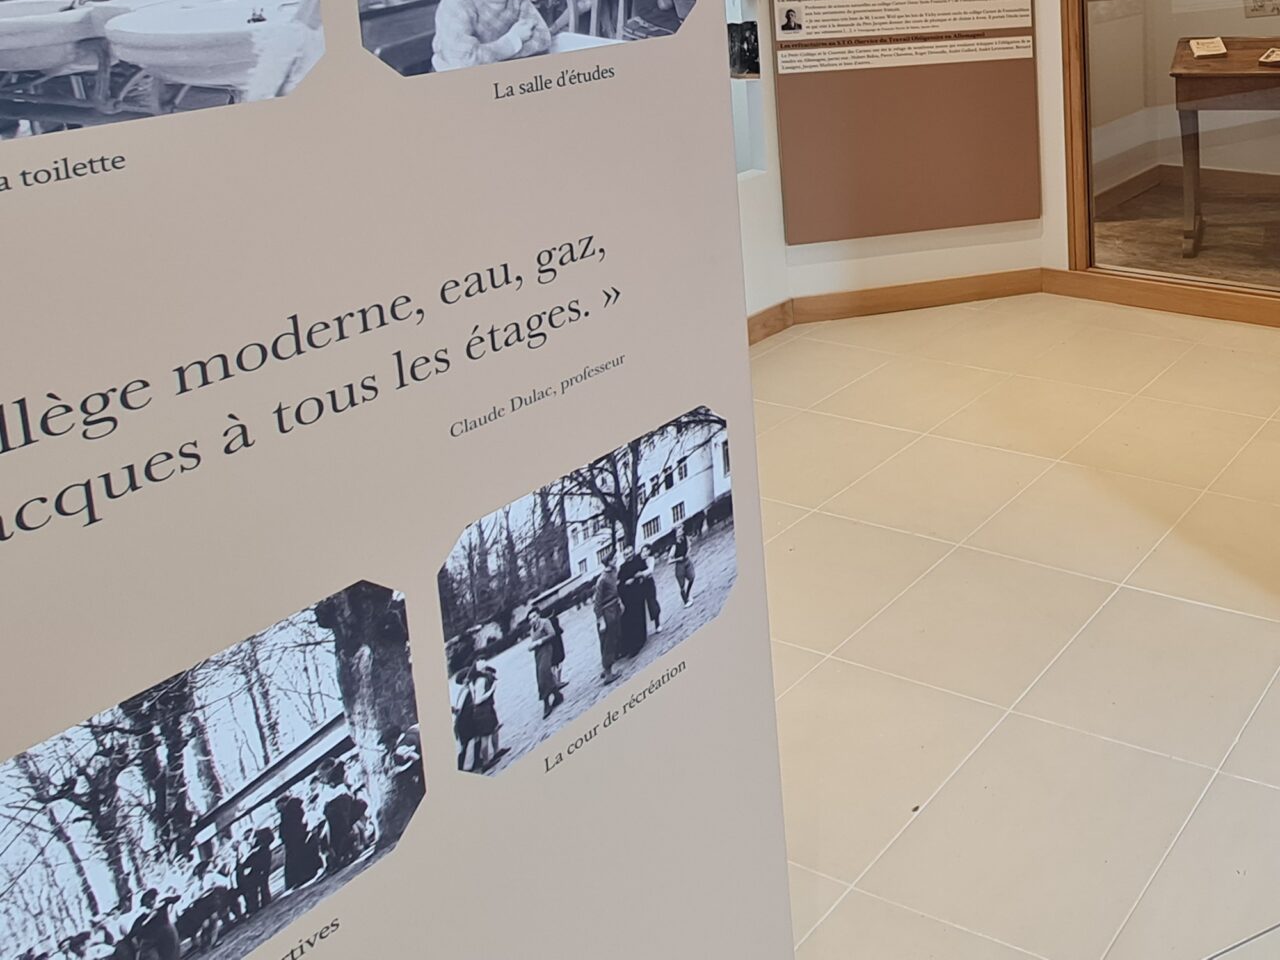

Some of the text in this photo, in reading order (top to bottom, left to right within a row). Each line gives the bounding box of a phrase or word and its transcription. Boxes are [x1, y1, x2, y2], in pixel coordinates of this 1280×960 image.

[493, 65, 615, 100] La salle d'études
[20, 154, 126, 187] toilette
[172, 293, 425, 396] moderne,
[439, 262, 523, 305] eau,
[536, 234, 605, 285] gaz,
[223, 413, 255, 455] à
[272, 374, 379, 434] tous
[392, 348, 451, 390] les
[465, 297, 590, 360] étages.
[450, 353, 625, 438] Claude Dulac, professeur
[544, 660, 687, 774] La cour de récréation
